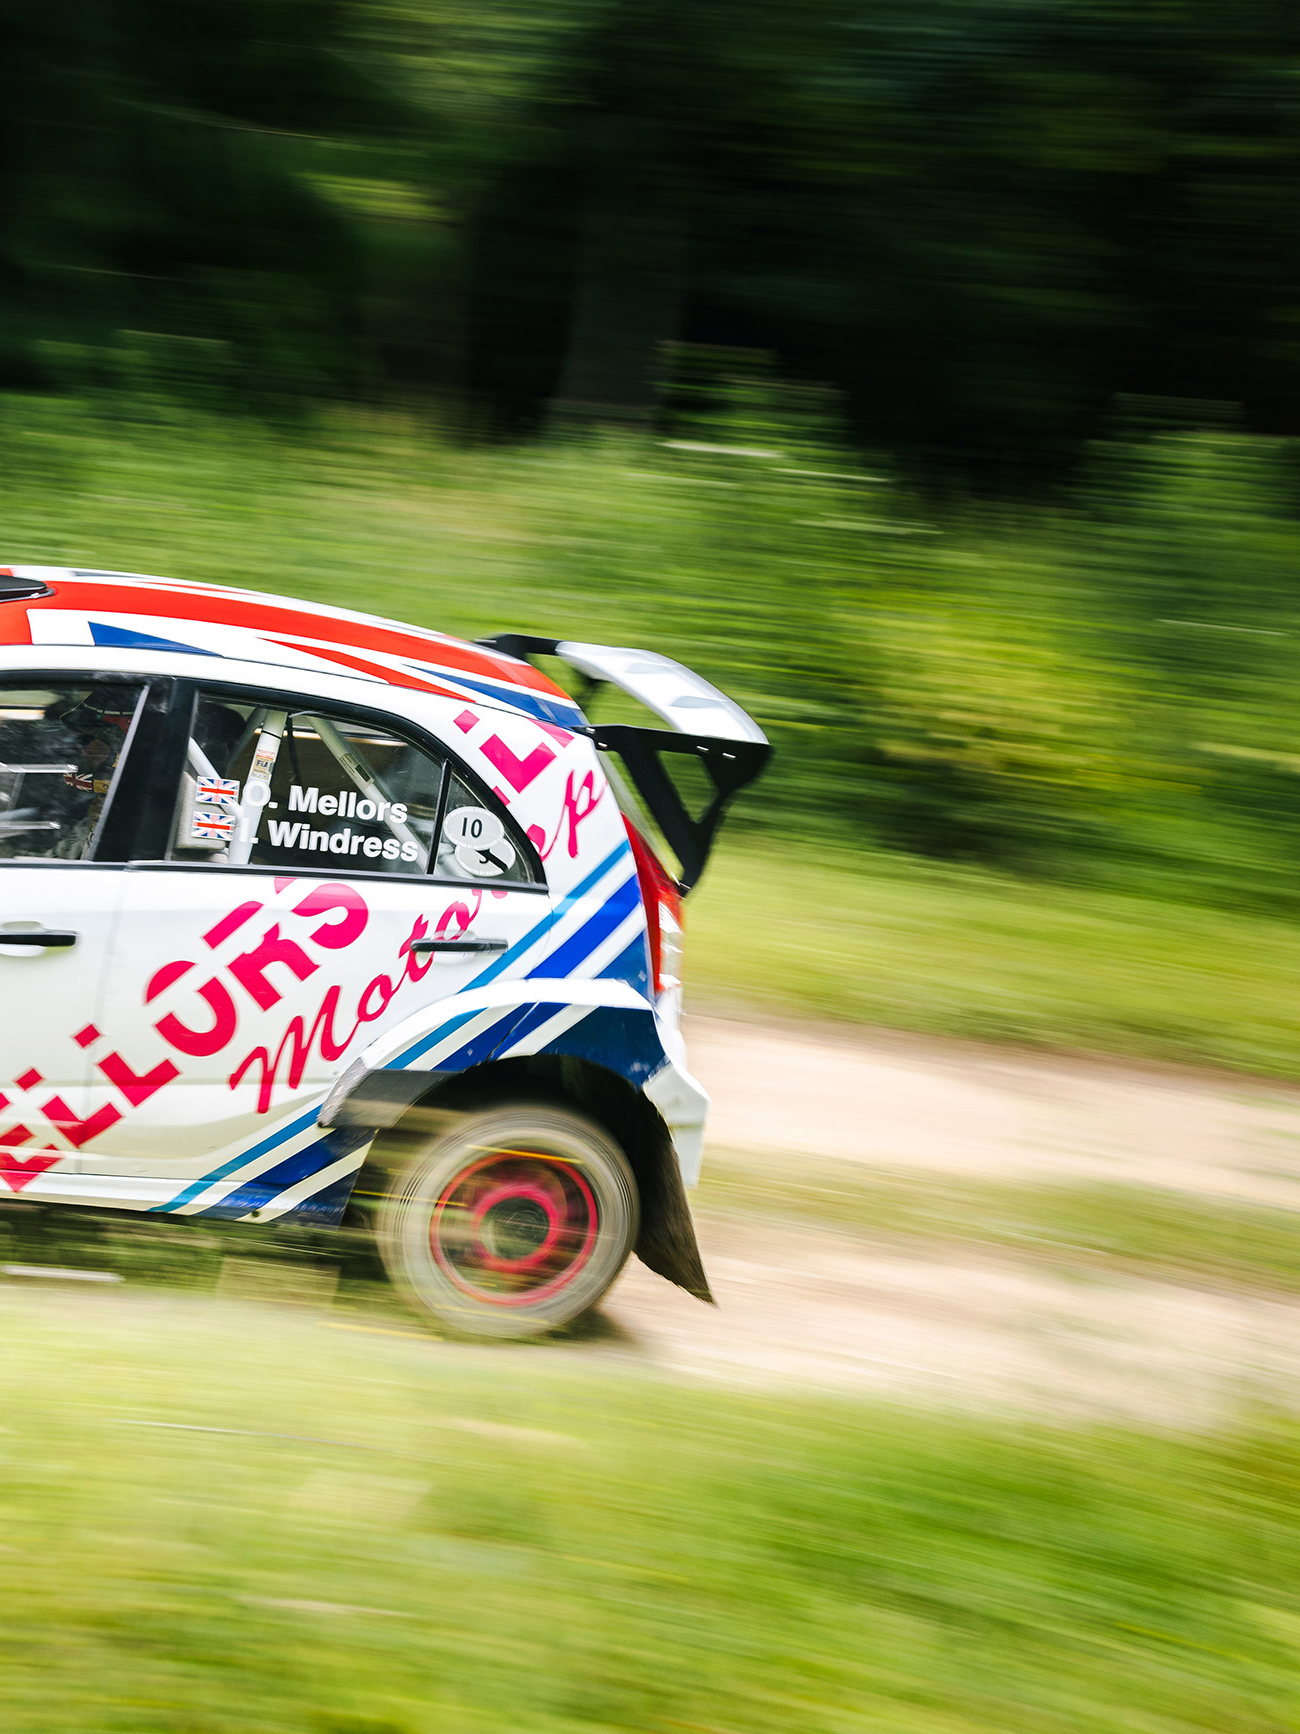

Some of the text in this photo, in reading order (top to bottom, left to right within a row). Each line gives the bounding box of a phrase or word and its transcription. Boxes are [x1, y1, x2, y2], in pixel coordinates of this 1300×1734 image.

[242, 780, 408, 824] O. Mellors
[267, 819, 419, 862] Windress
[461, 817, 483, 838] 10
